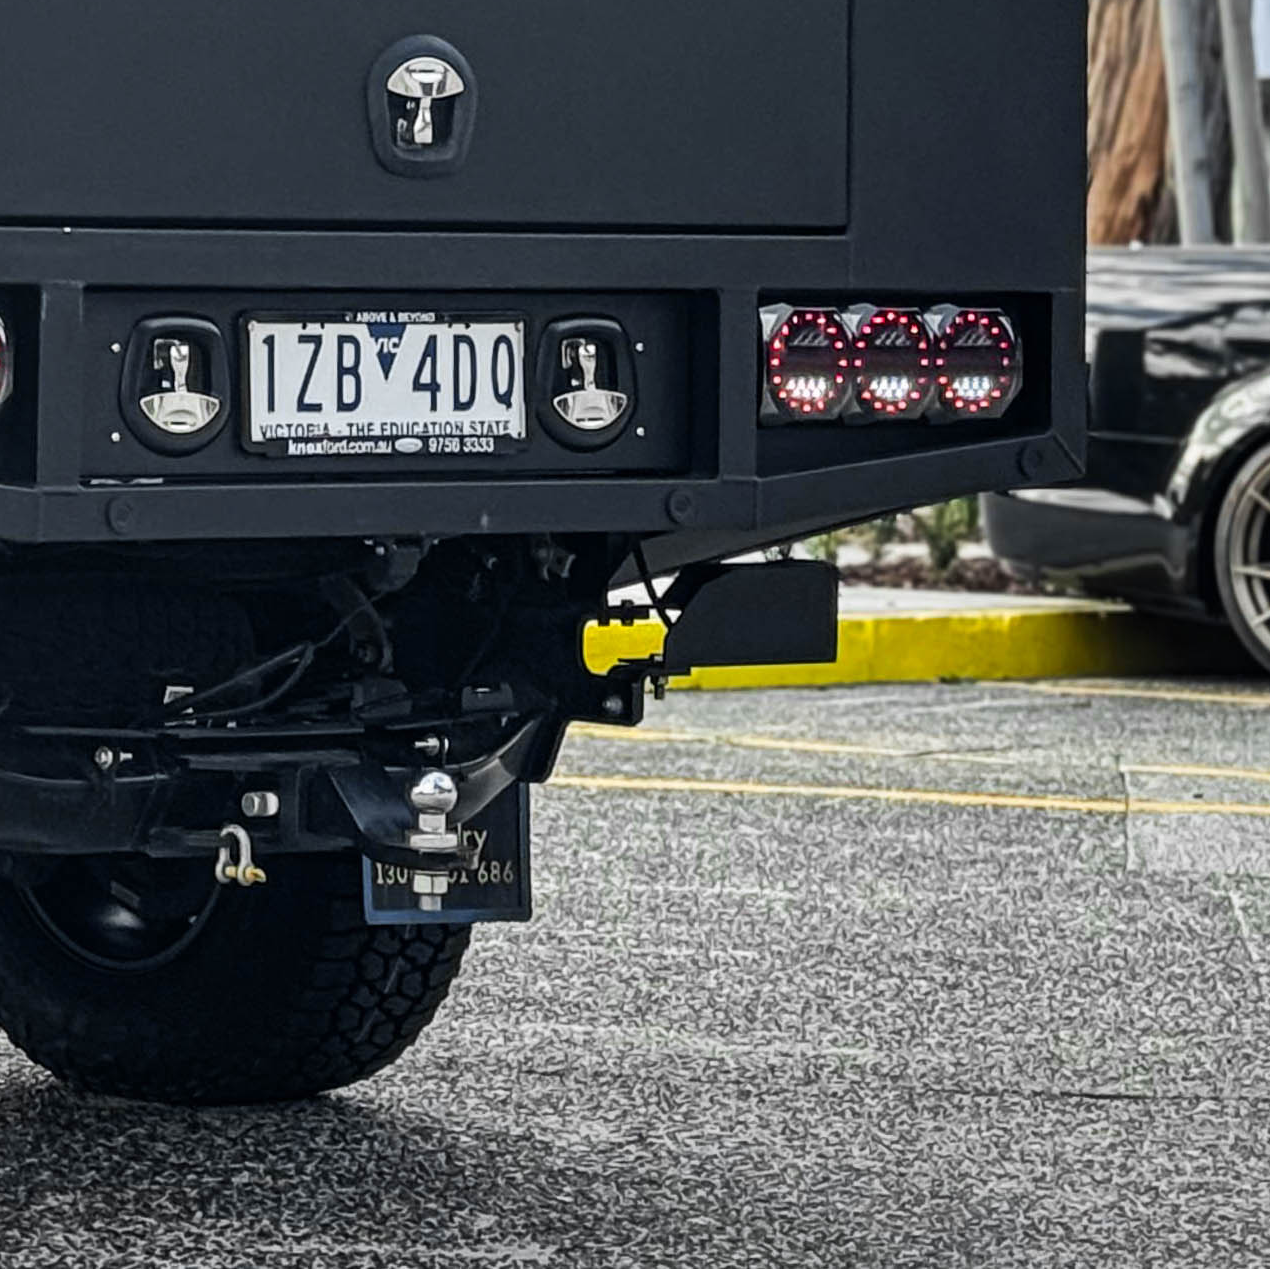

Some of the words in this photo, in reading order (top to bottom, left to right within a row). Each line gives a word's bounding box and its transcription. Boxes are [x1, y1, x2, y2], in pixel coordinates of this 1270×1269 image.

[356, 312, 387, 323] ABOVE
[375, 337, 400, 354] VIC
[262, 334, 362, 413] 1ZB
[412, 334, 515, 412] 4DQ
[260, 423, 330, 439] VICTORIA
[346, 422, 376, 436] THE
[381, 421, 464, 436] EDUCATION
[469, 420, 510, 435] STATE
[477, 861, 514, 884] 686
